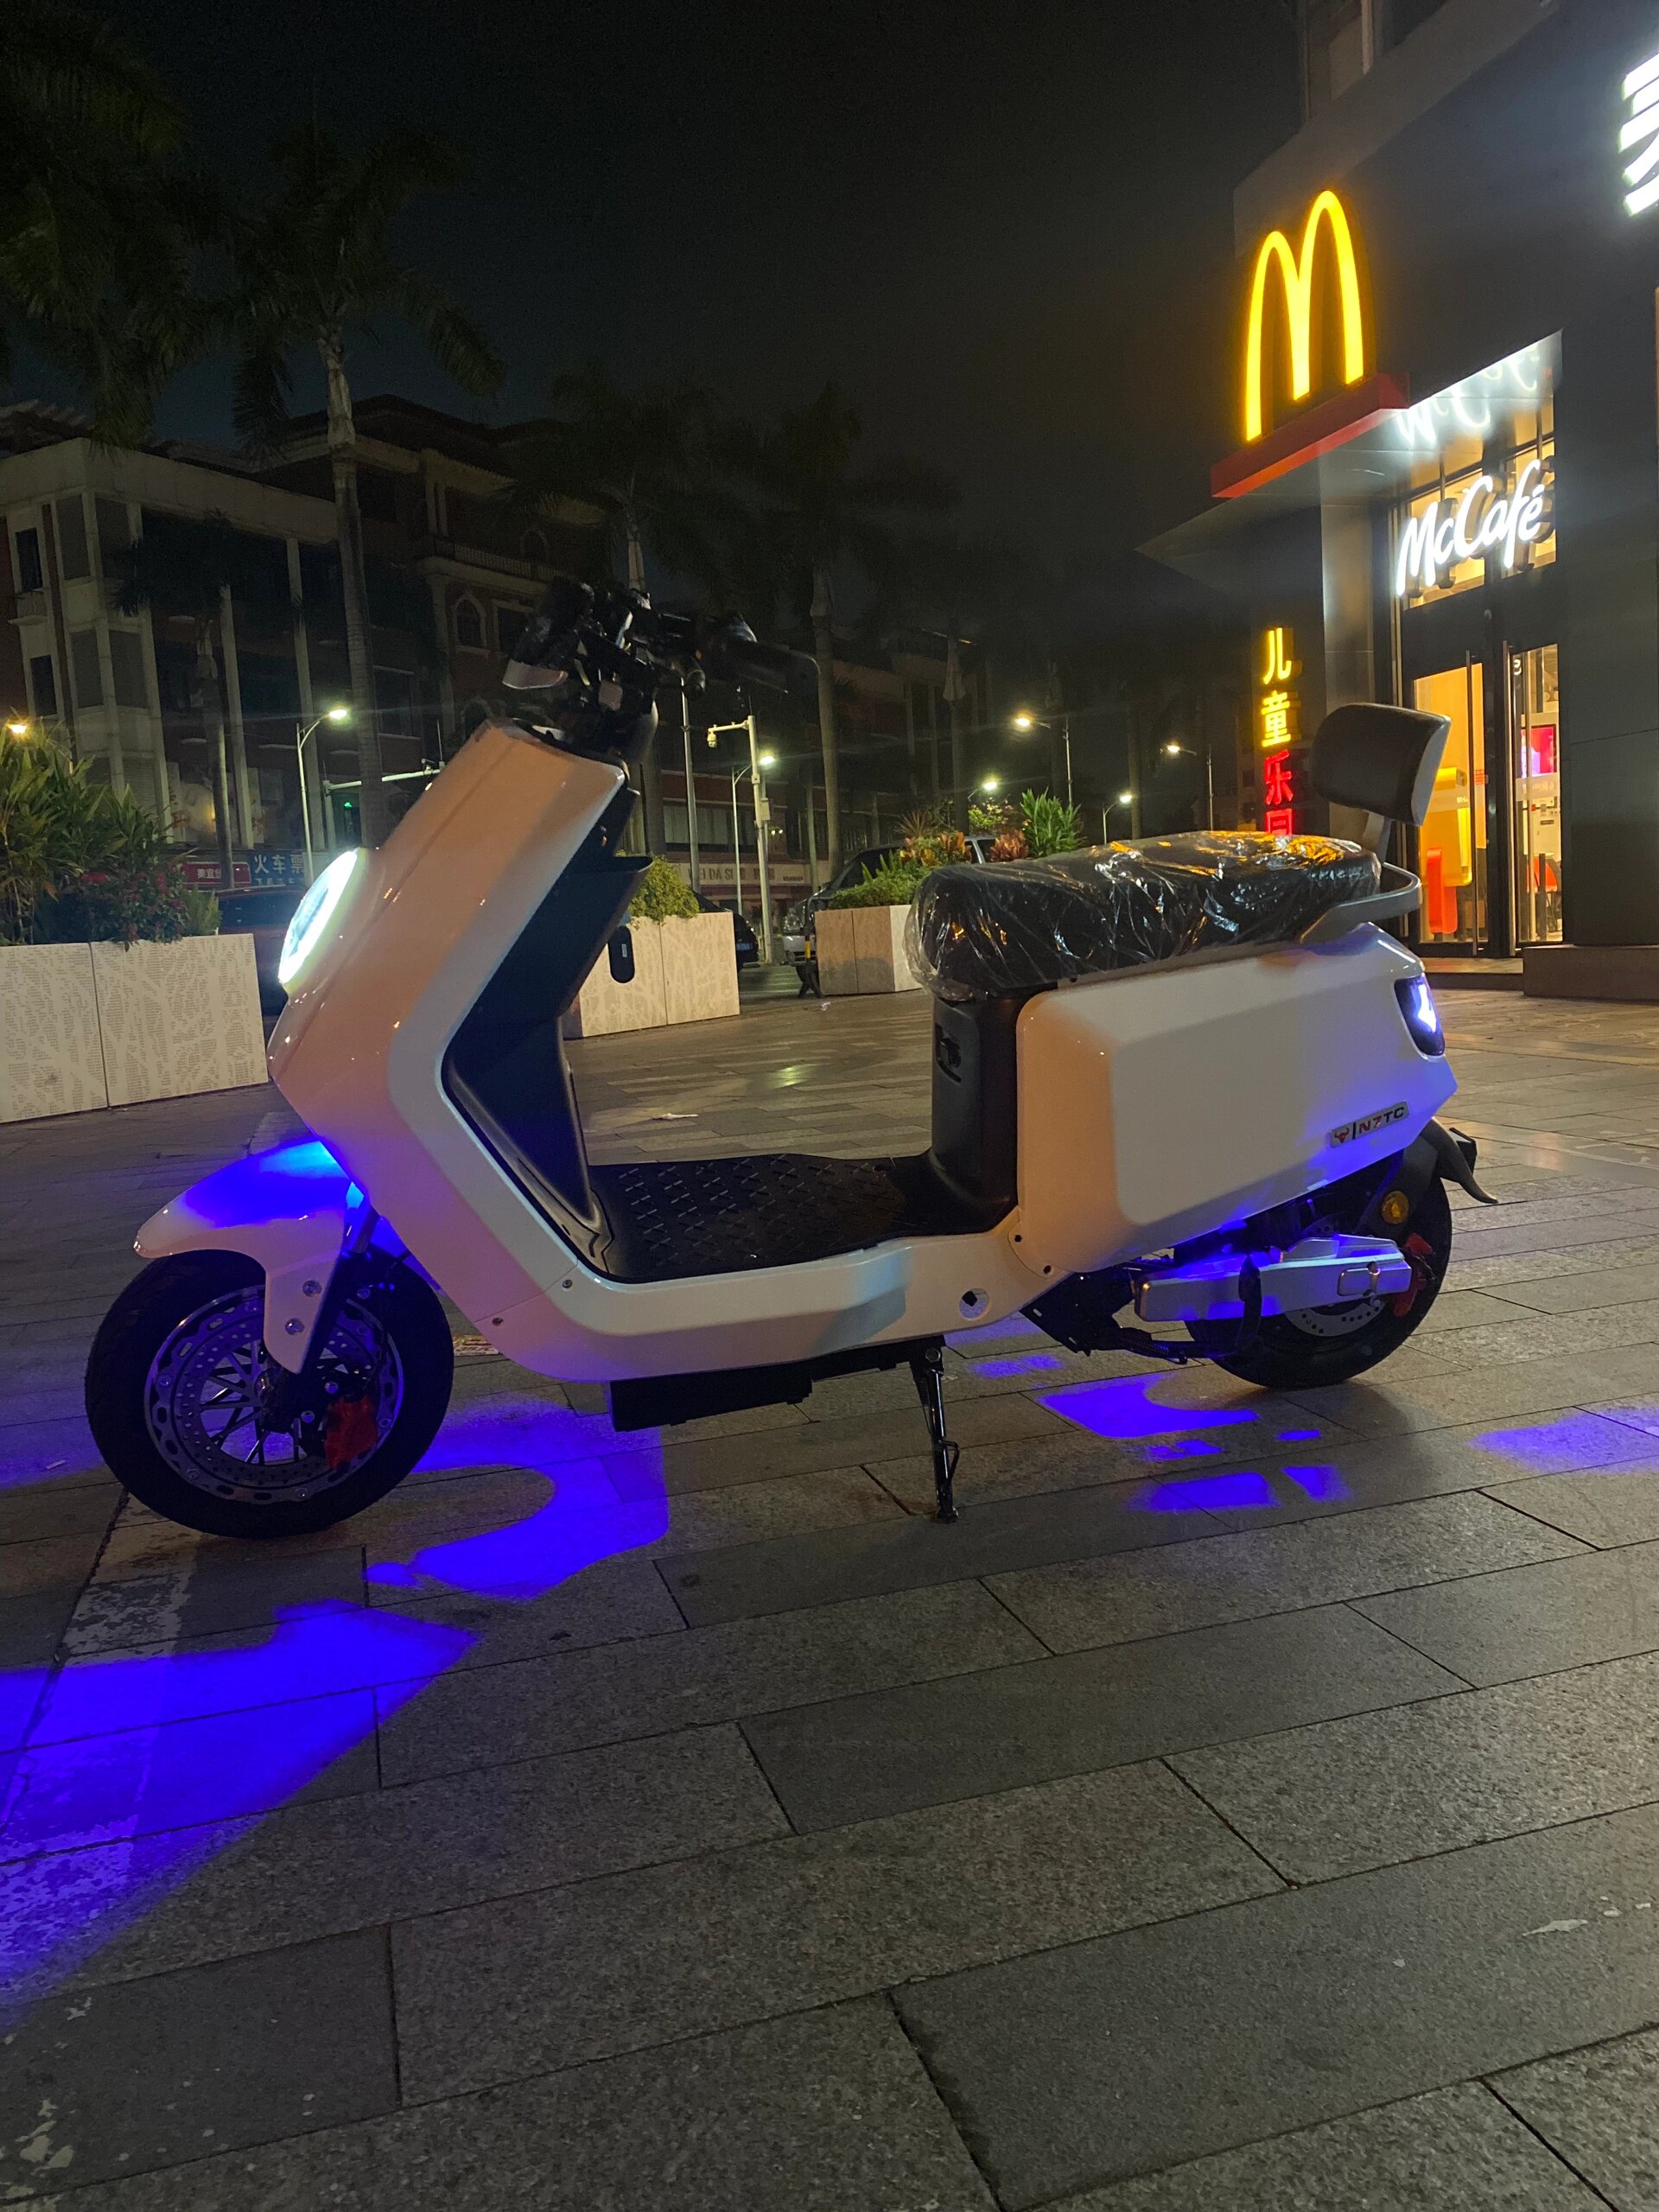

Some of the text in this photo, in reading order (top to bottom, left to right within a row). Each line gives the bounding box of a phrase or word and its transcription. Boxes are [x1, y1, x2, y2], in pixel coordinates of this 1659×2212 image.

[1396, 459, 1545, 596] McCafé
[254, 854, 303, 874] 火车票
[1359, 1107, 1404, 1134] N7TC
